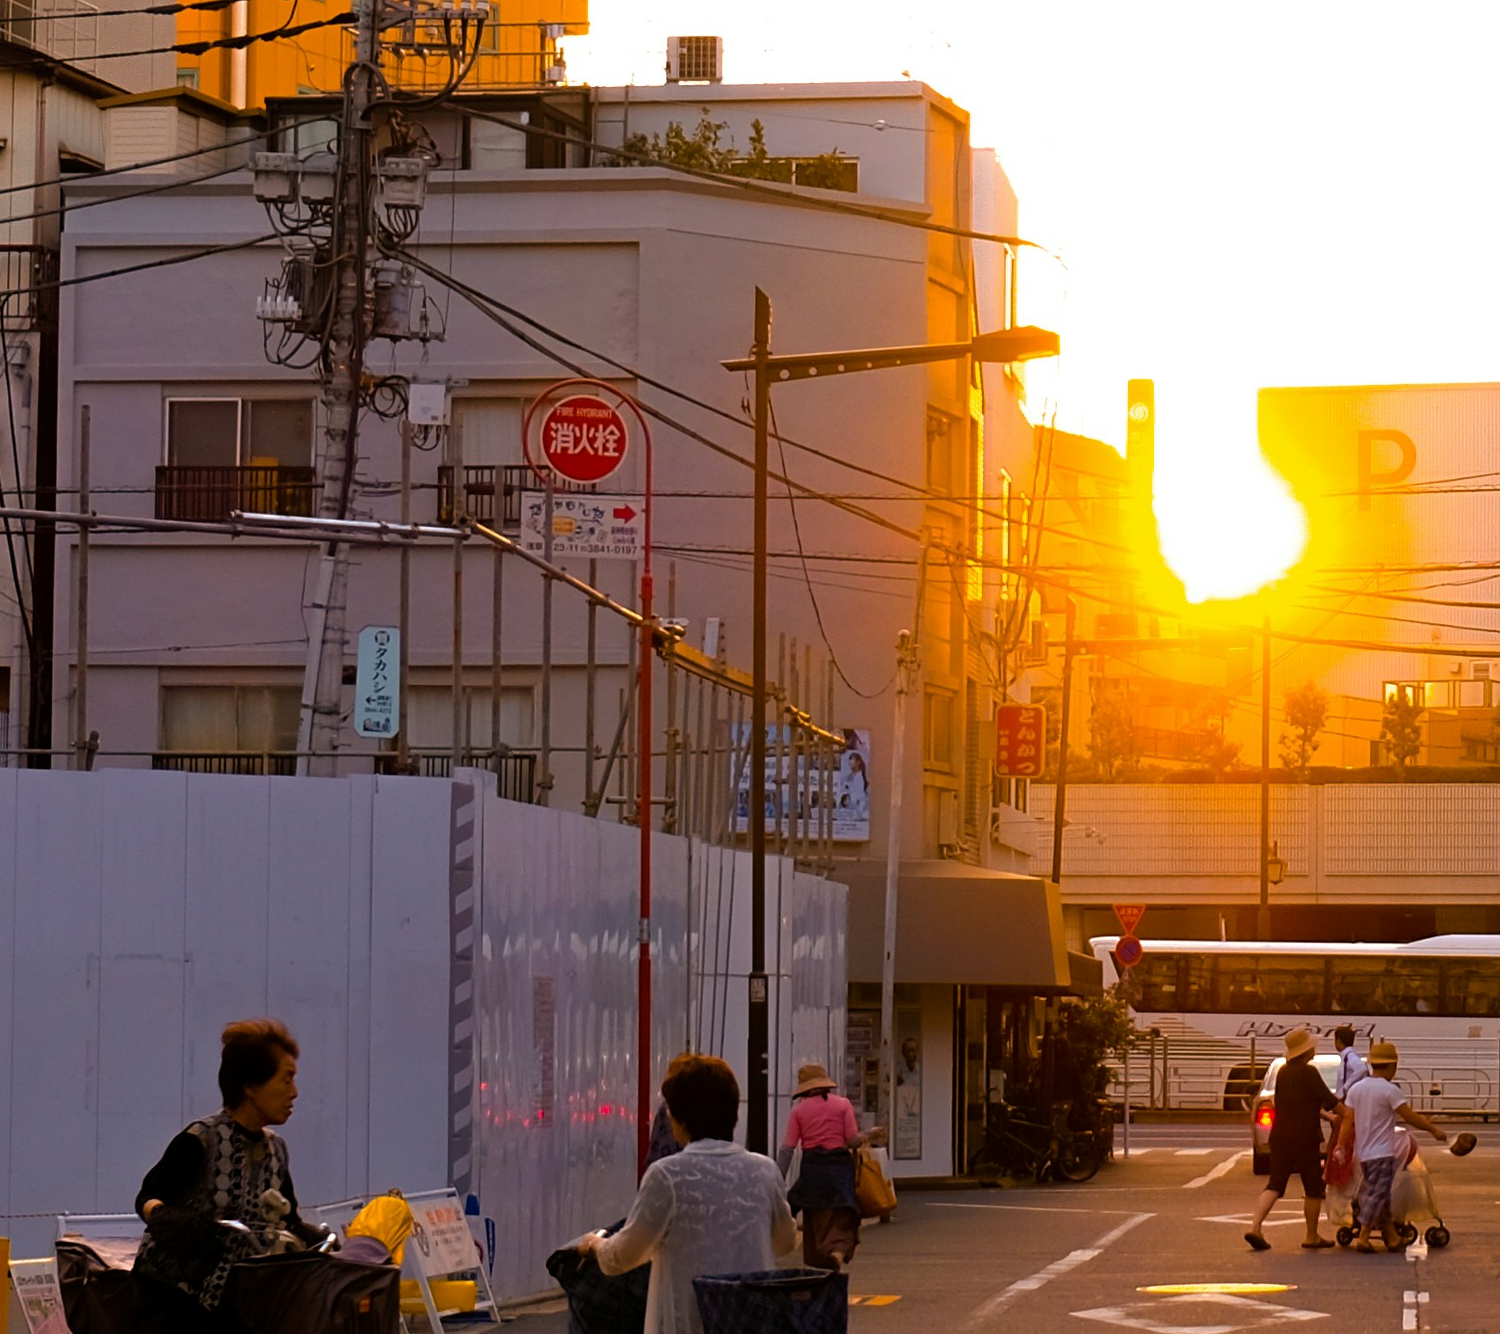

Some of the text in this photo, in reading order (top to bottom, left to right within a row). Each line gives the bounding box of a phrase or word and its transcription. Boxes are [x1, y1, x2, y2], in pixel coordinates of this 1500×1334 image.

[556, 407, 613, 418] FIRE HYDRANT
[550, 421, 620, 457] 消火栓
[1358, 429, 1417, 511] P
[372, 647, 388, 694] タカハシ
[1235, 1020, 1376, 1038] Hybrd
